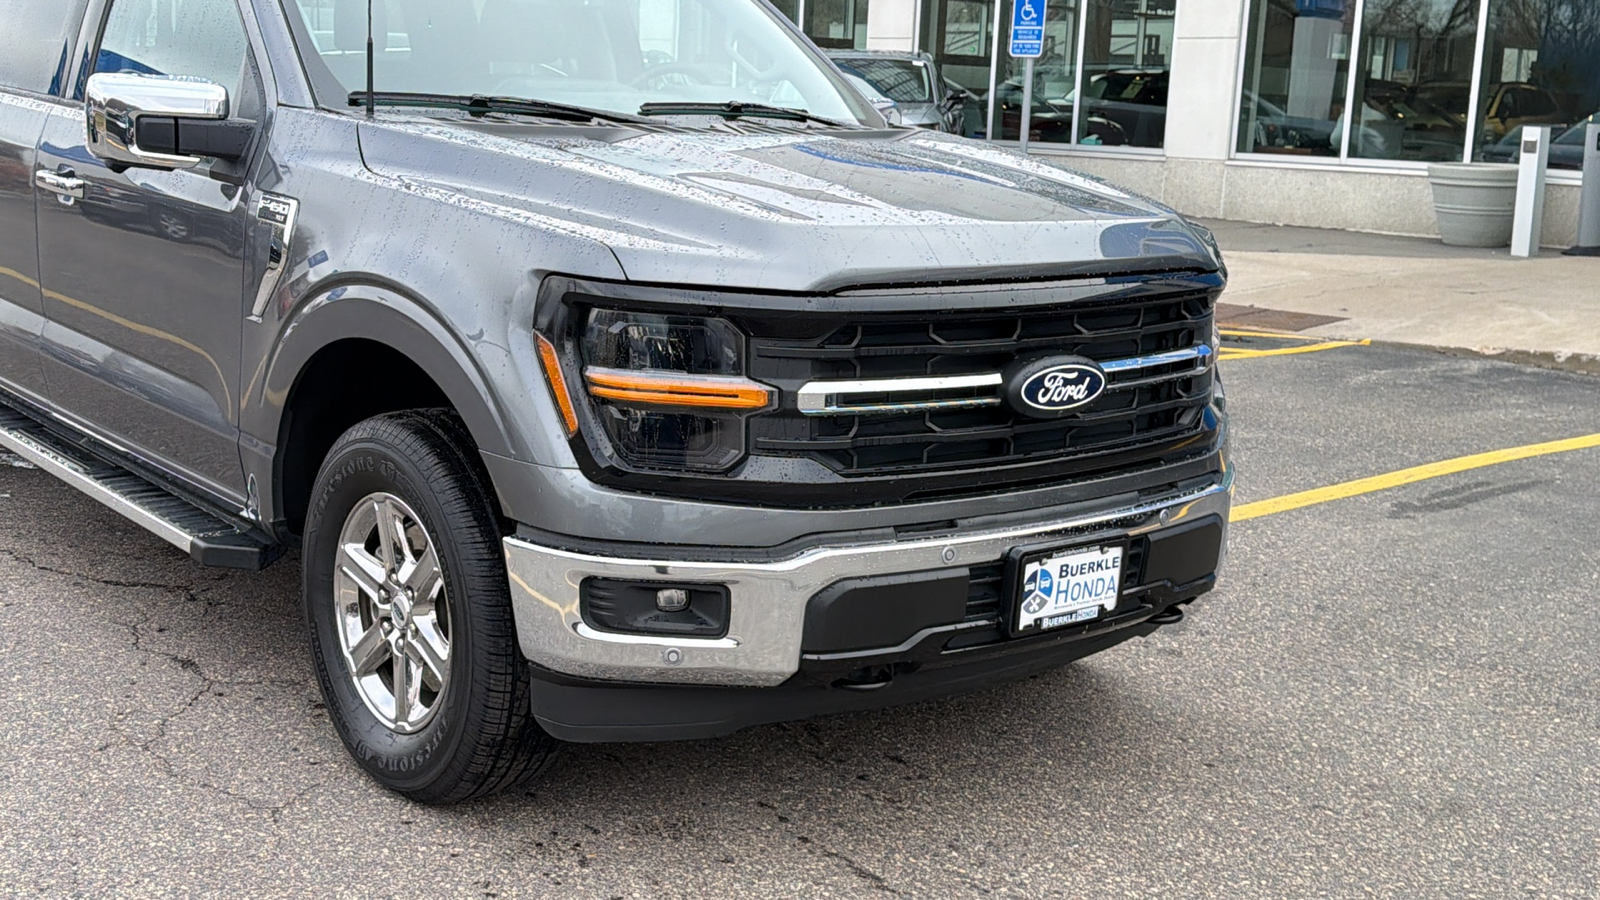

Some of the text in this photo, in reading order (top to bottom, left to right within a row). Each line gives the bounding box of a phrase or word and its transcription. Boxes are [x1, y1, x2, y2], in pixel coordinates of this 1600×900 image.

[1037, 371, 1091, 403] Ford
[1059, 557, 1119, 578] BUERKLE
[1055, 575, 1116, 605] HONDA
[1042, 608, 1097, 628] BUERKLE HONDA
